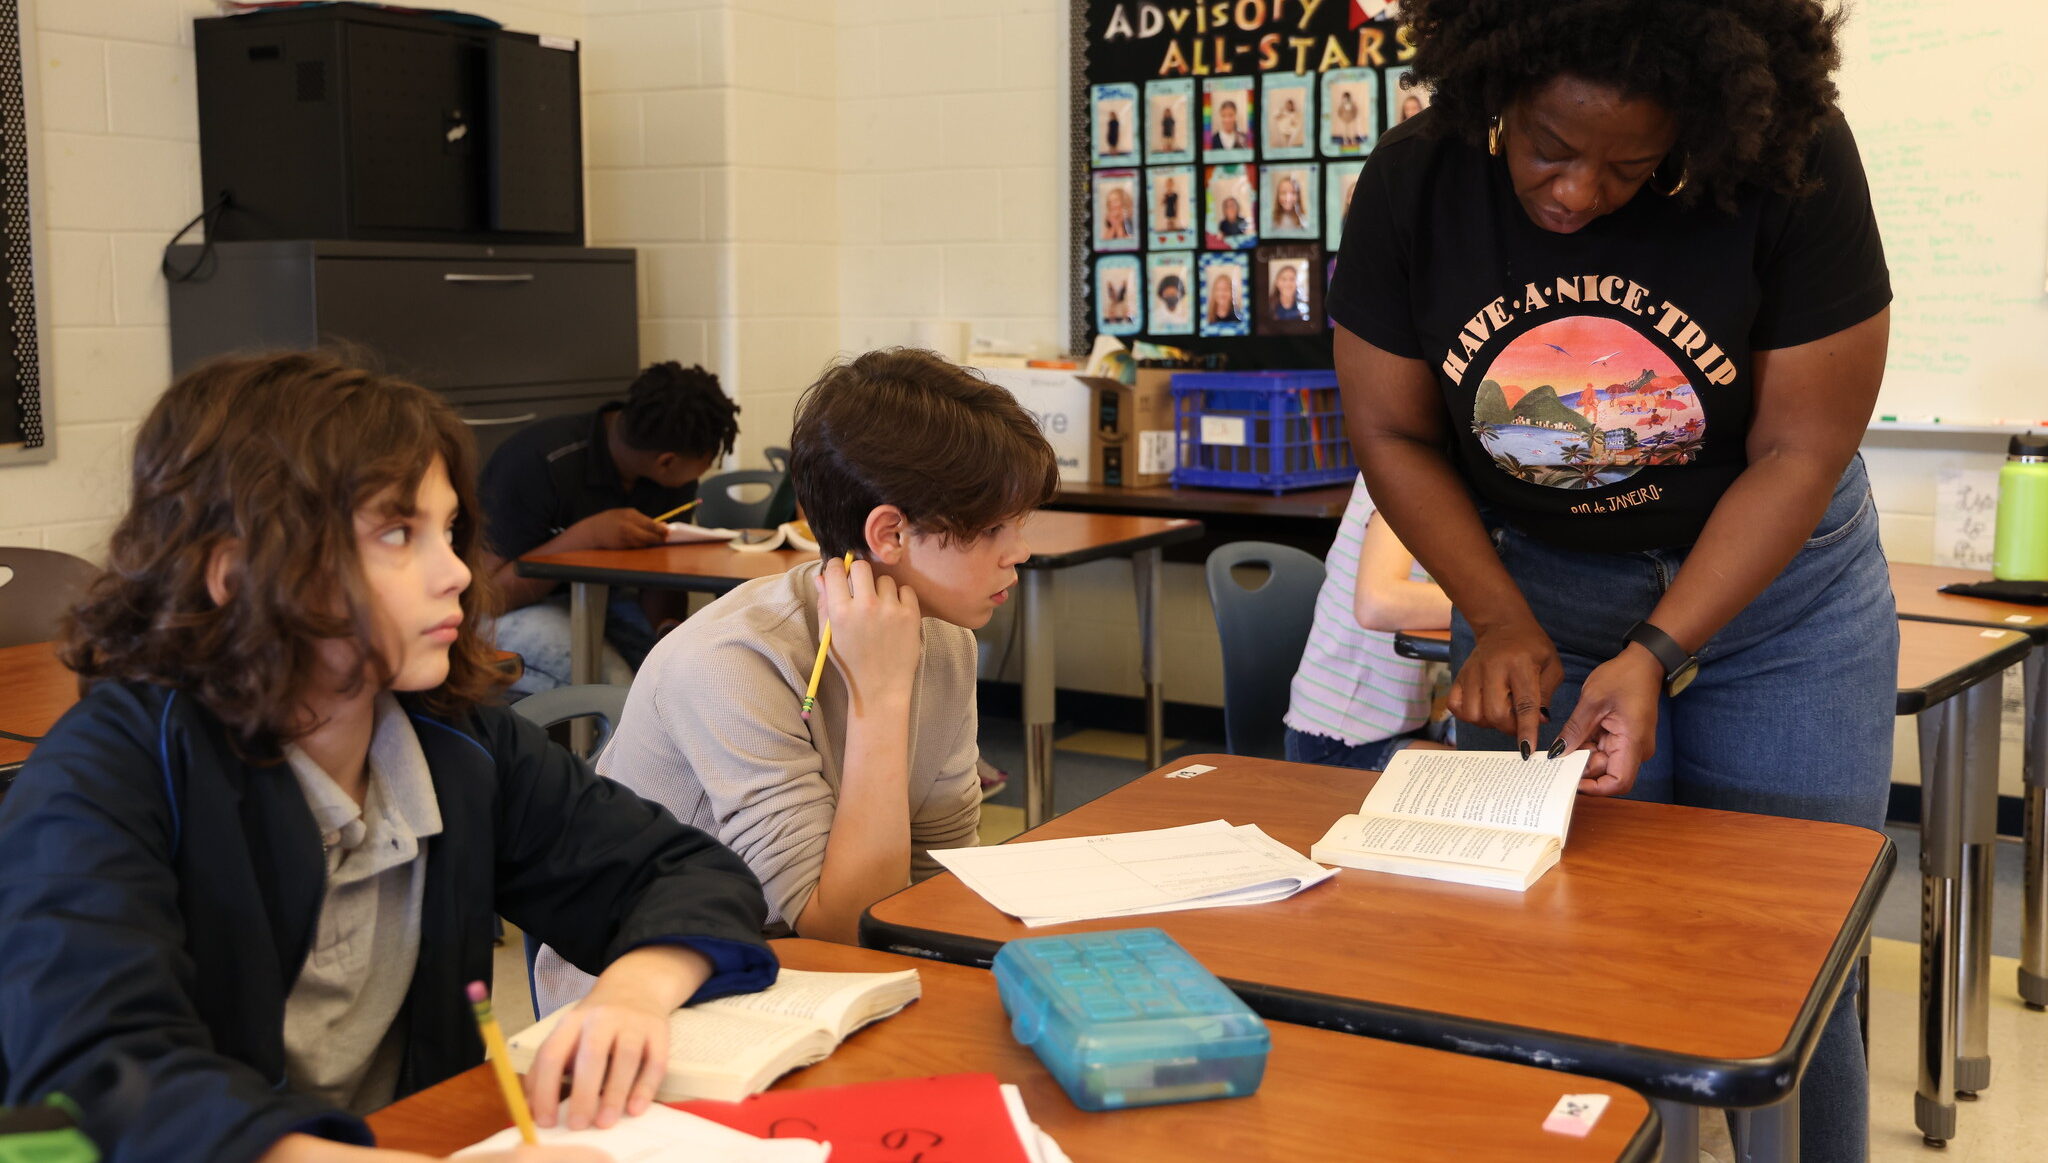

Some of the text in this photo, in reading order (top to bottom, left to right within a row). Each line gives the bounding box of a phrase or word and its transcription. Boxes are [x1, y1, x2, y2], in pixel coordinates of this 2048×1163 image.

[1442, 274, 1737, 386] HAVE A NICE TRIP
